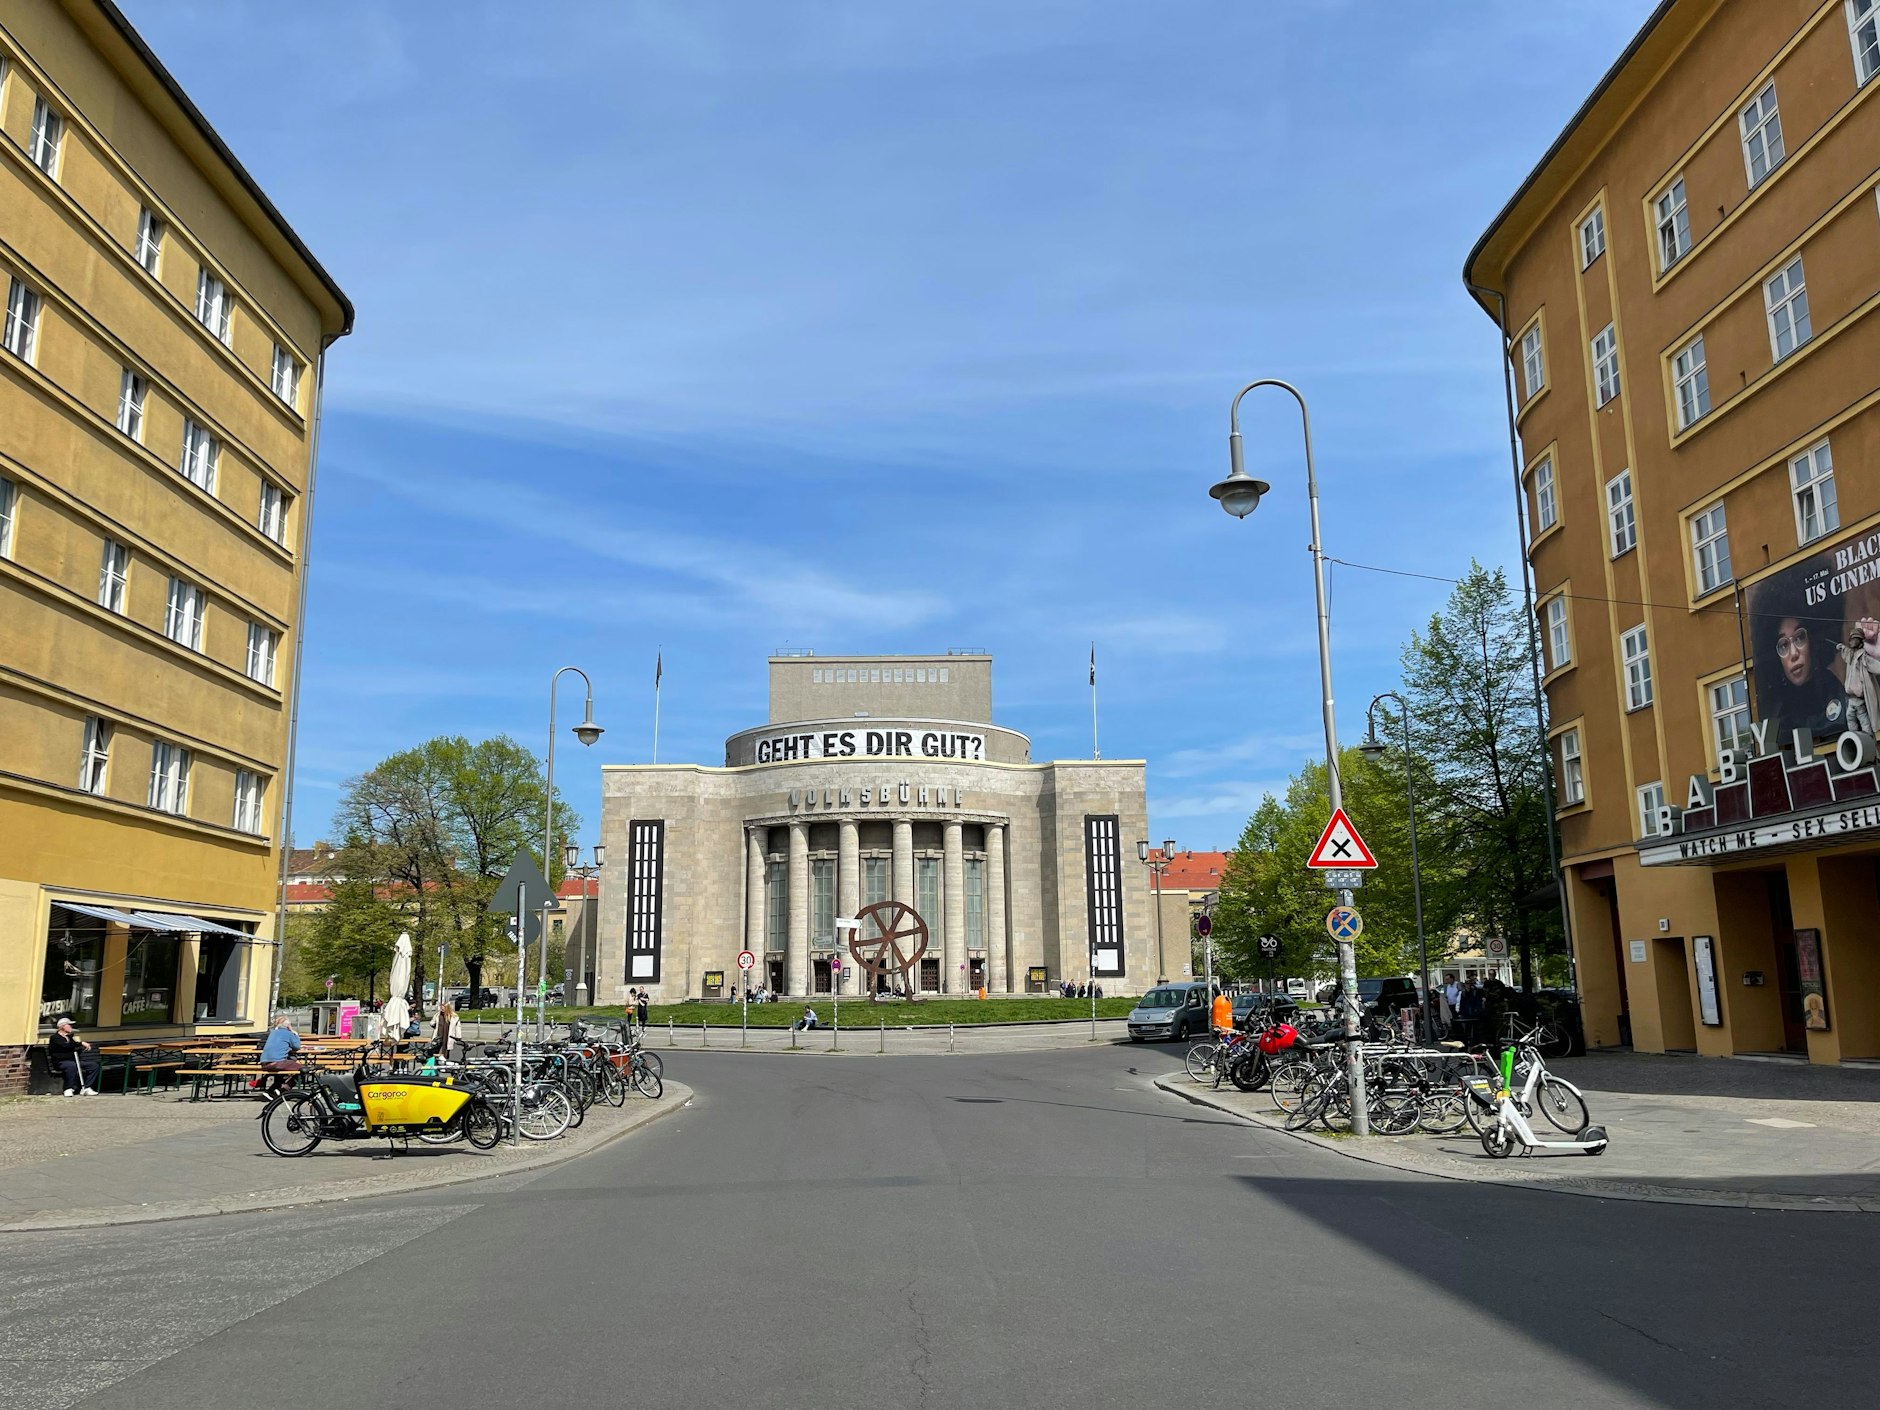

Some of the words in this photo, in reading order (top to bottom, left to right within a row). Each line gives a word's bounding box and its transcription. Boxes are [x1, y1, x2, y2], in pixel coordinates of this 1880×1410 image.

[1805, 581, 1827, 606] US
[757, 734, 814, 764] GEHT
[823, 731, 856, 757] ES
[866, 731, 913, 757] DIR
[921, 732, 982, 760] GUT?
[788, 778, 964, 807] VOLKSBÜHNE
[1679, 835, 1728, 859] WATCH
[1737, 831, 1757, 848] ME
[1792, 818, 1826, 840] SEX
[741, 955, 752, 965] 30
[40, 999, 73, 1017] PIZZERIA
